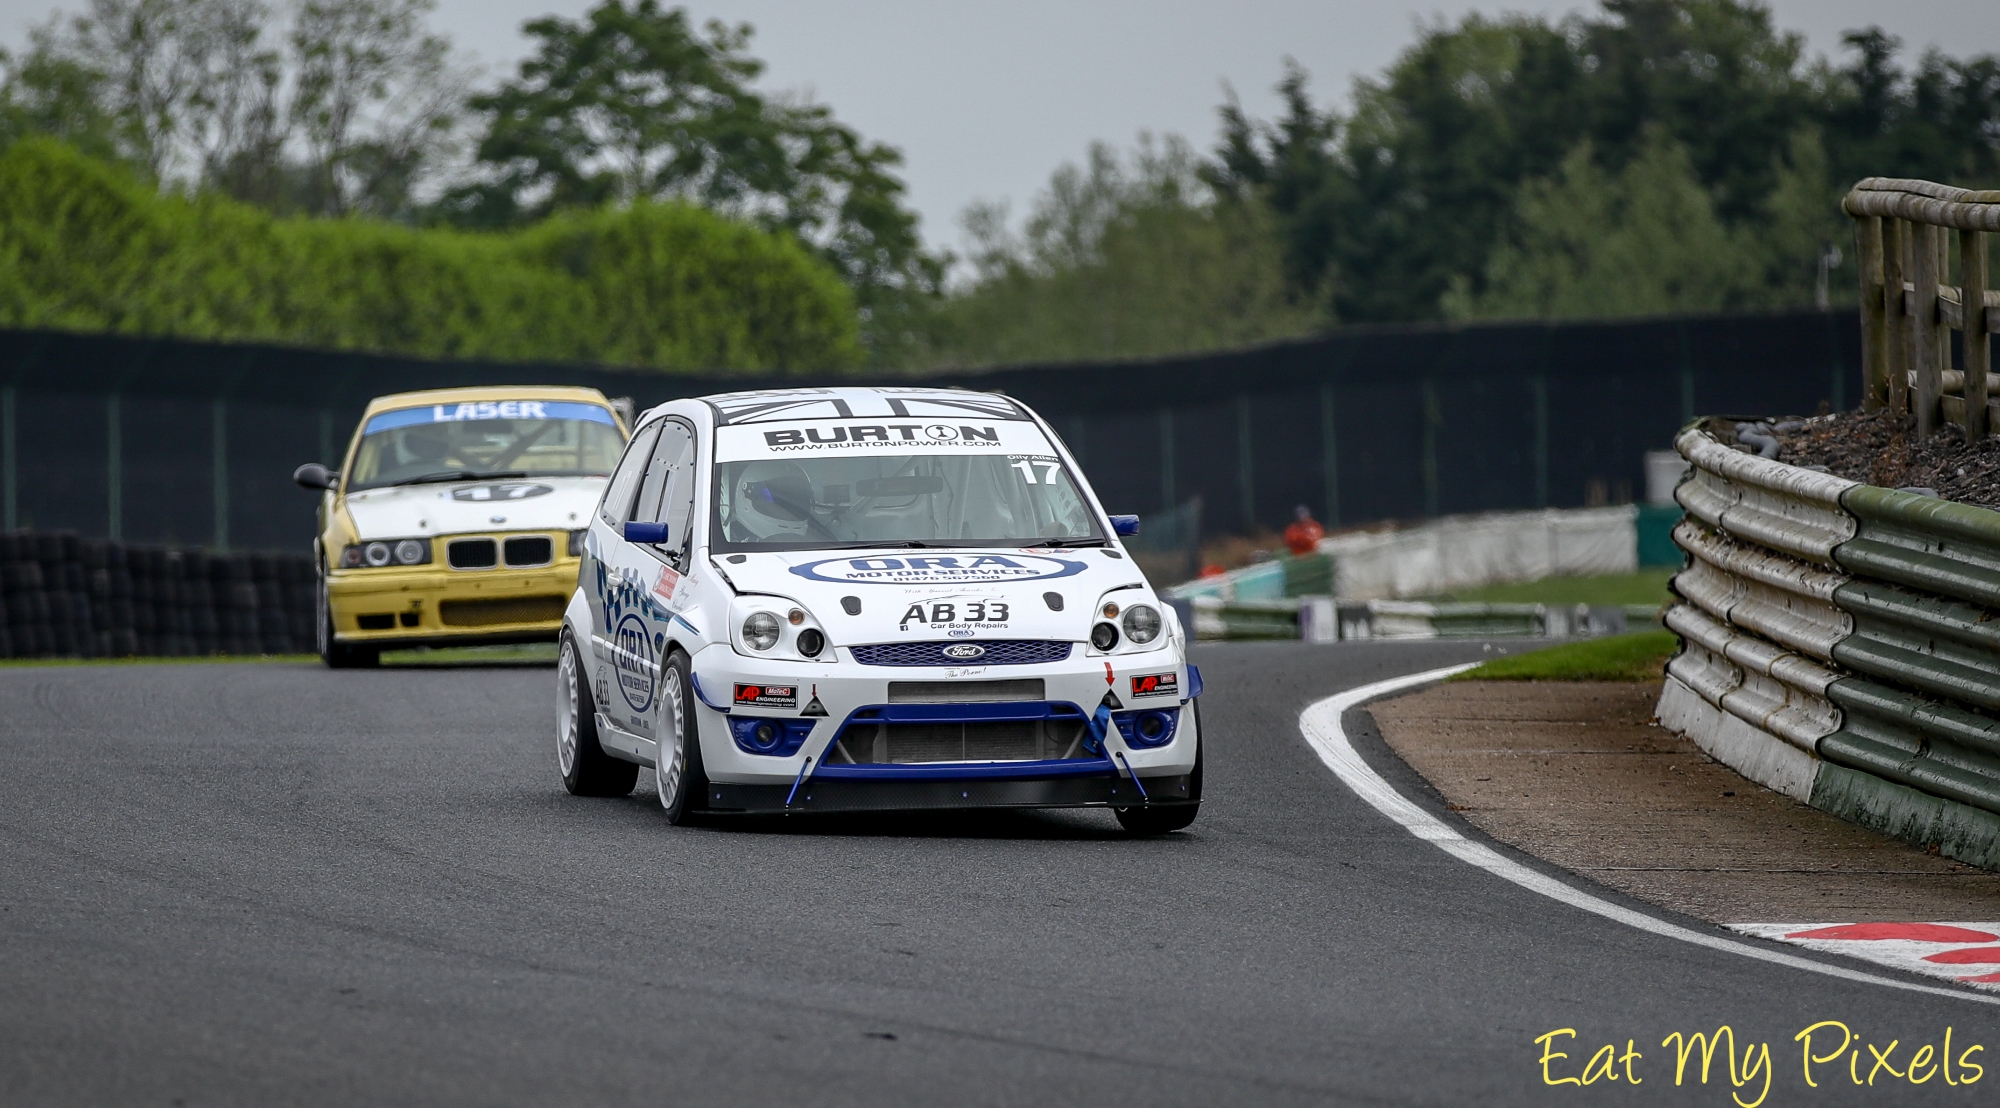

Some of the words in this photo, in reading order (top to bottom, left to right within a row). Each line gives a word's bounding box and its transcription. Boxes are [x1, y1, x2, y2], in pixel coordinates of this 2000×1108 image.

[433, 401, 548, 422] LASER
[1010, 460, 1061, 485] 17
[456, 484, 538, 500] 17
[848, 556, 1027, 571] ORA
[846, 570, 929, 579] MOTOR
[933, 569, 1041, 577] SERVICES
[899, 604, 956, 625] AB
[964, 603, 1009, 622] 33
[975, 622, 1009, 630] Repairs
[620, 628, 645, 675] ORA
[952, 646, 976, 656] Ford
[736, 684, 760, 701] LAP
[1132, 676, 1158, 693] LAP
